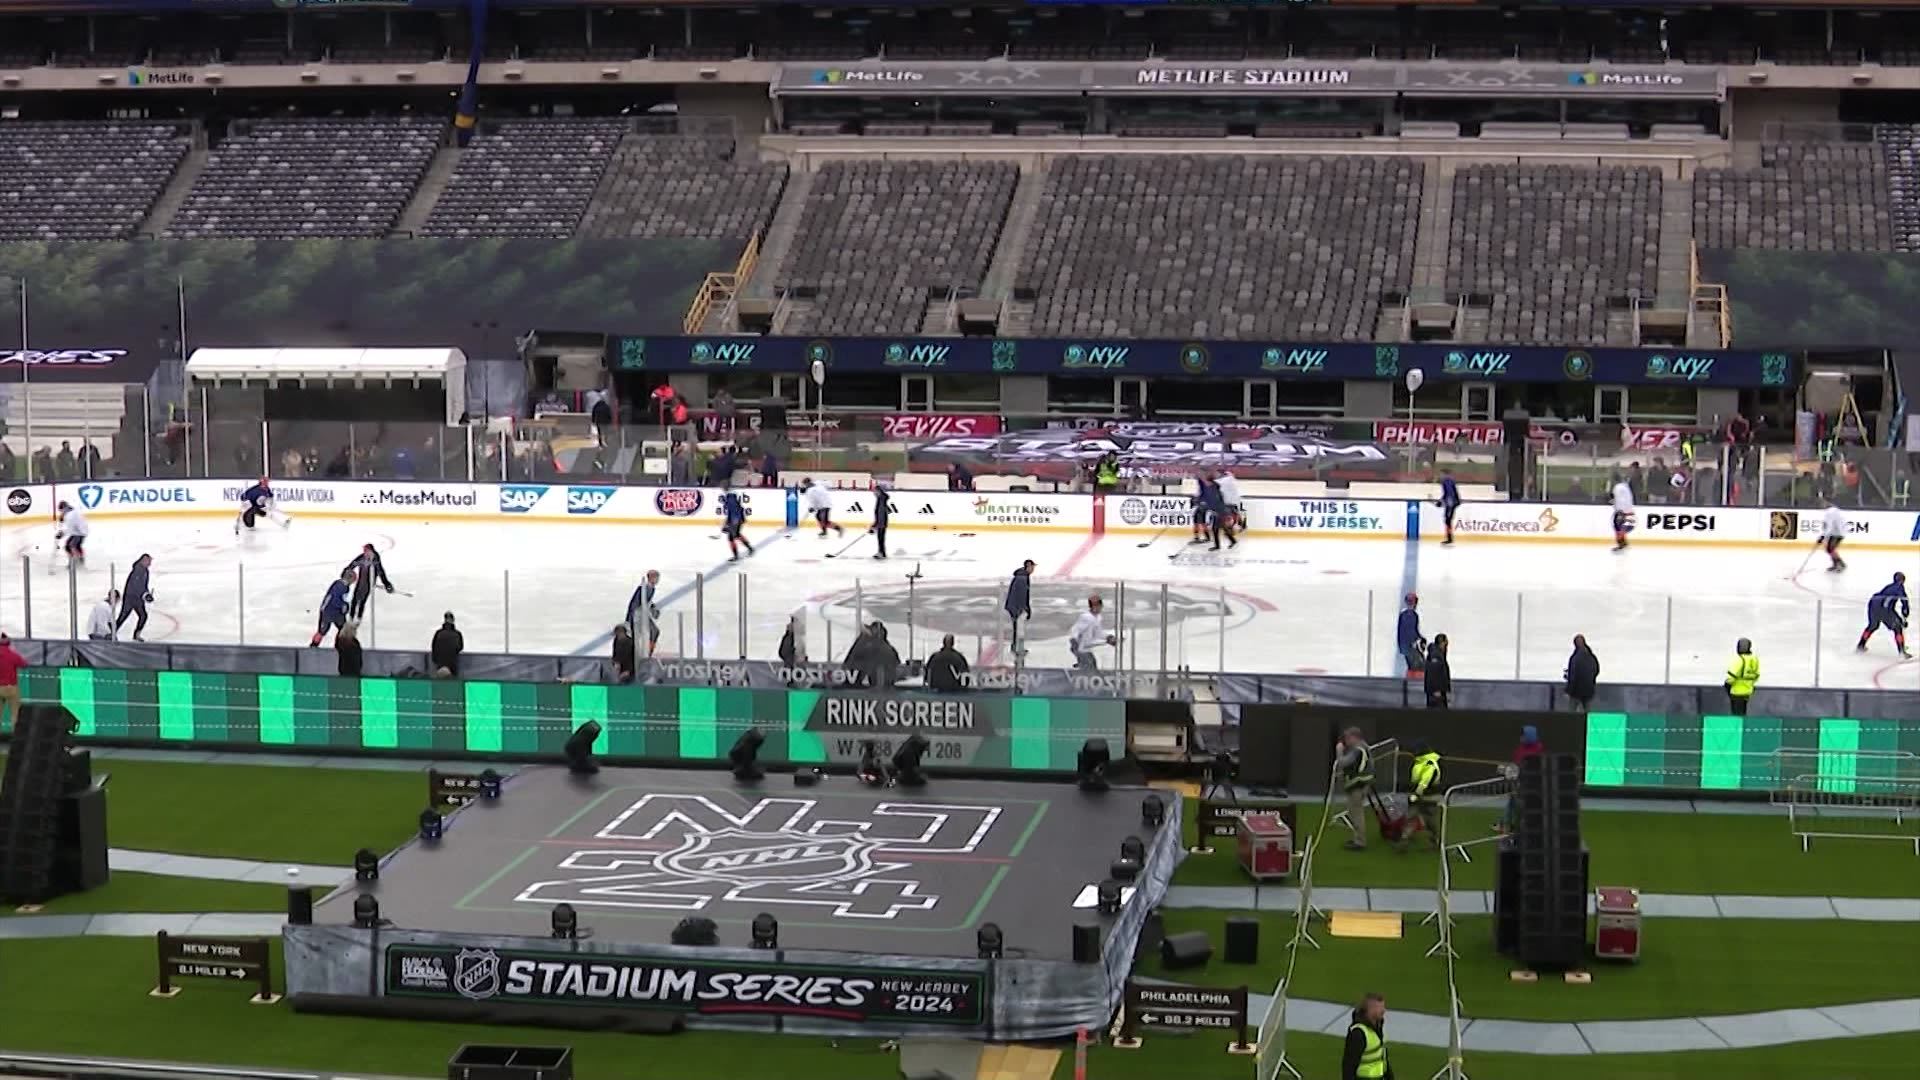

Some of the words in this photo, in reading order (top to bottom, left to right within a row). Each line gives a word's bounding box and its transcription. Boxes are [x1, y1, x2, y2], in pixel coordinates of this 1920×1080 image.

[148, 72, 194, 85] MetLife
[845, 70, 923, 82] MetLife
[1137, 69, 1236, 84] METLIFE
[1243, 70, 1349, 84] STADIUM
[1602, 74, 1683, 84] MetLife
[883, 416, 976, 438] DEVILS
[109, 489, 196, 505] FANDUEL
[379, 490, 477, 506] MassMutual
[501, 490, 539, 508] SAP
[568, 490, 606, 509] SAP
[1149, 499, 1186, 510] NAVY
[1300, 501, 1336, 514] THIS
[1342, 502, 1358, 514] IS
[1150, 513, 1192, 526] CREDI
[1274, 515, 1313, 528] NEW
[1455, 519, 1540, 533] AstraZeneca
[1646, 513, 1716, 531] PEPSI
[826, 698, 879, 725] RINK
[885, 700, 974, 728] SCREEN
[837, 739, 855, 756] W
[934, 741, 963, 760] 208
[702, 843, 838, 869] NHL
[183, 943, 209, 954] NEW
[210, 945, 241, 957] YORK
[505, 959, 697, 1001] STADIUM
[697, 971, 875, 1006] SERIES
[881, 980, 913, 992] NEW
[918, 981, 970, 995] JERSEY
[894, 994, 954, 1013] 2024
[1140, 990, 1231, 1005] PHILADELPHIA
[1194, 1016, 1231, 1027] MILES
